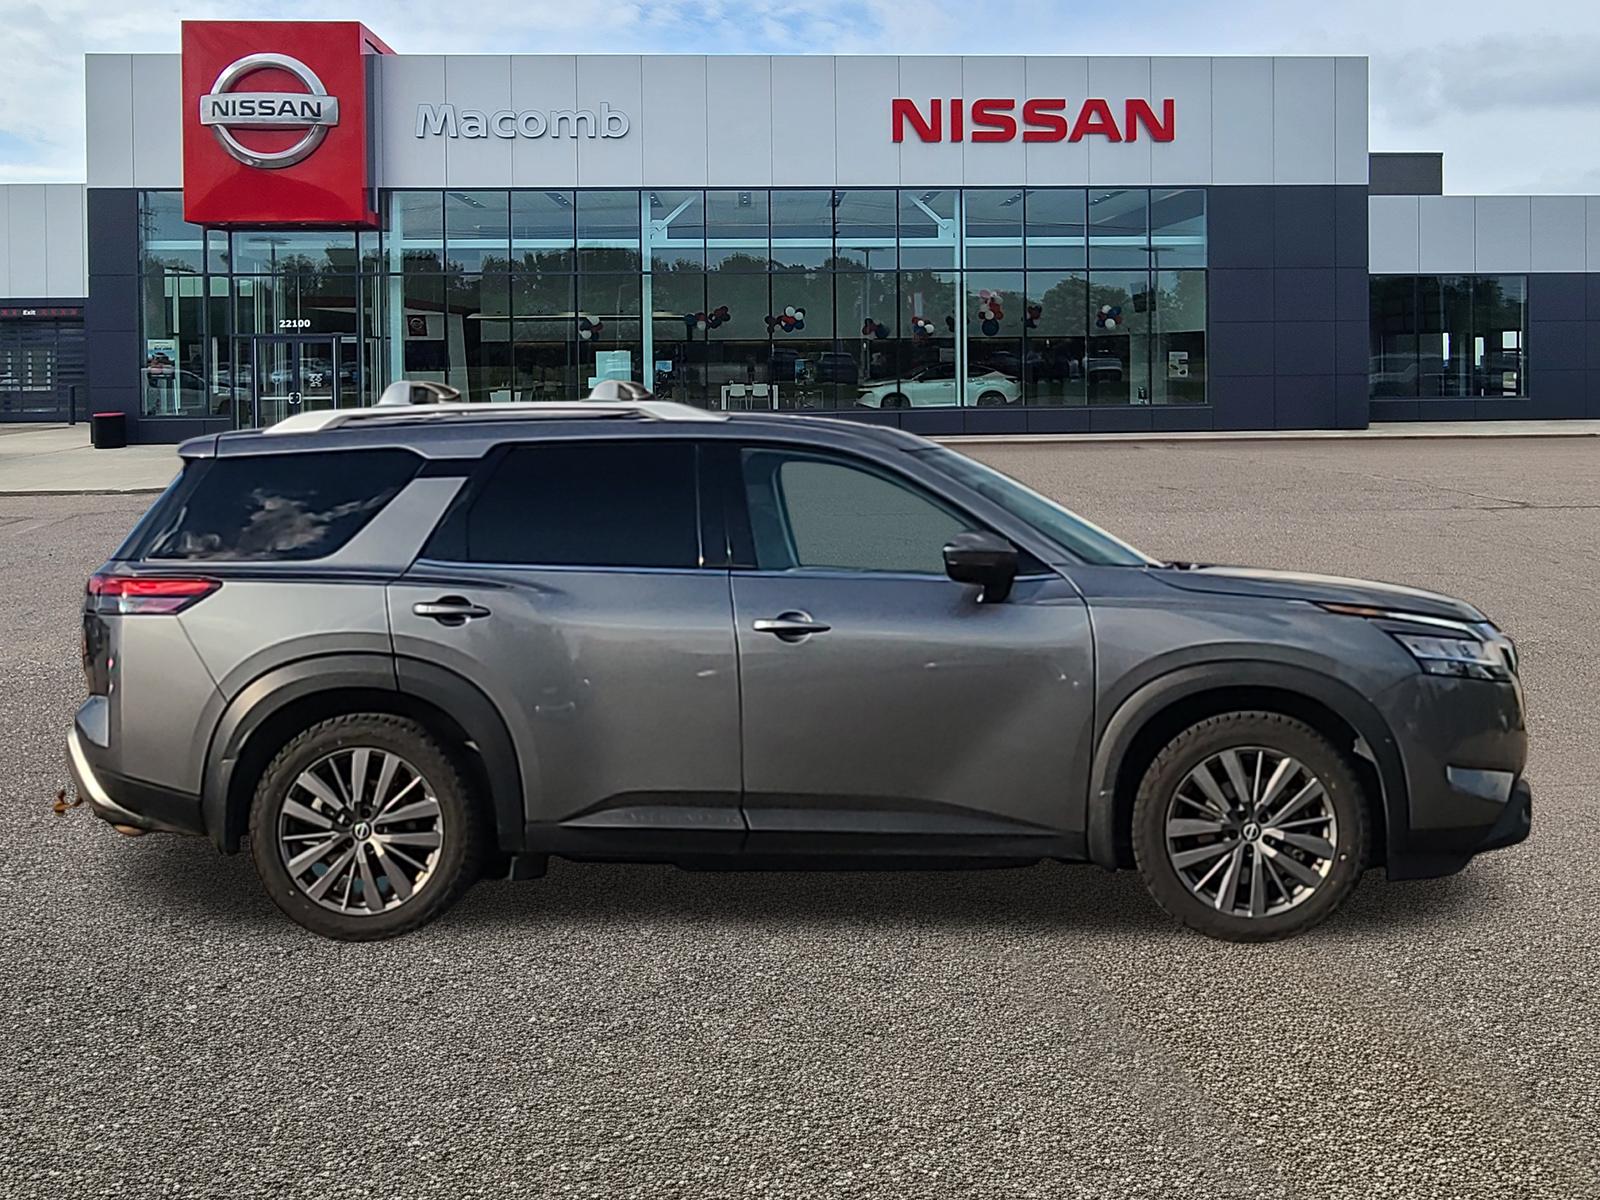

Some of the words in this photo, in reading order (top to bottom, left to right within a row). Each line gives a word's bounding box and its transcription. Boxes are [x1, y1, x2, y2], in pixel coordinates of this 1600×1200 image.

[211, 100, 322, 118] NISSAN
[415, 101, 630, 139] Macomb
[892, 98, 1176, 143] NISSAN
[279, 319, 311, 328] 22100
